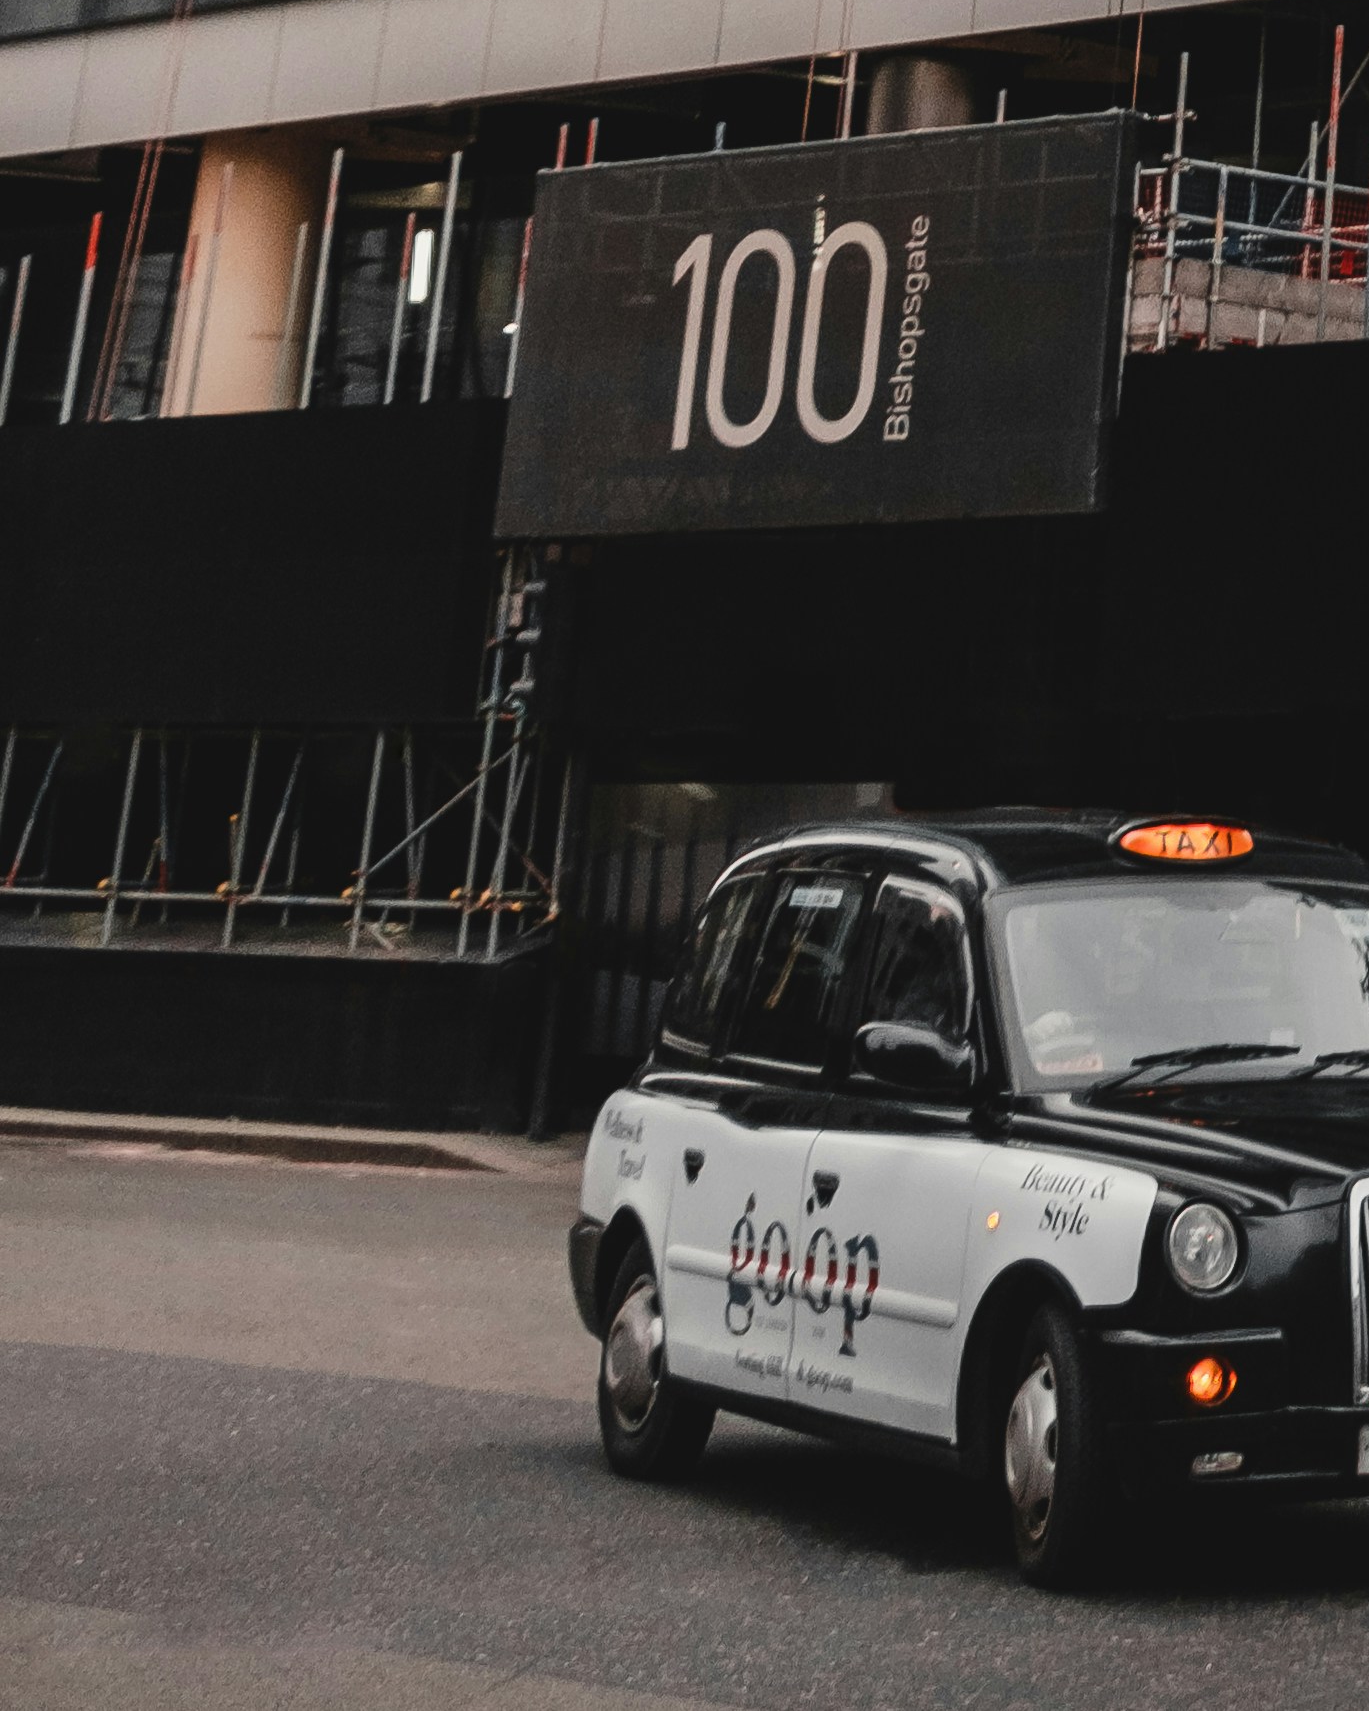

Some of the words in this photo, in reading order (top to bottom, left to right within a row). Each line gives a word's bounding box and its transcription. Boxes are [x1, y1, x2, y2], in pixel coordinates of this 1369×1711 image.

[671, 221, 888, 451] 100
[884, 215, 931, 442] Bishopsgate
[1154, 830, 1234, 855] TAXI
[1020, 1163, 1088, 1203] Beauty
[1090, 1176, 1117, 1201] &
[1038, 1199, 1090, 1243] Style
